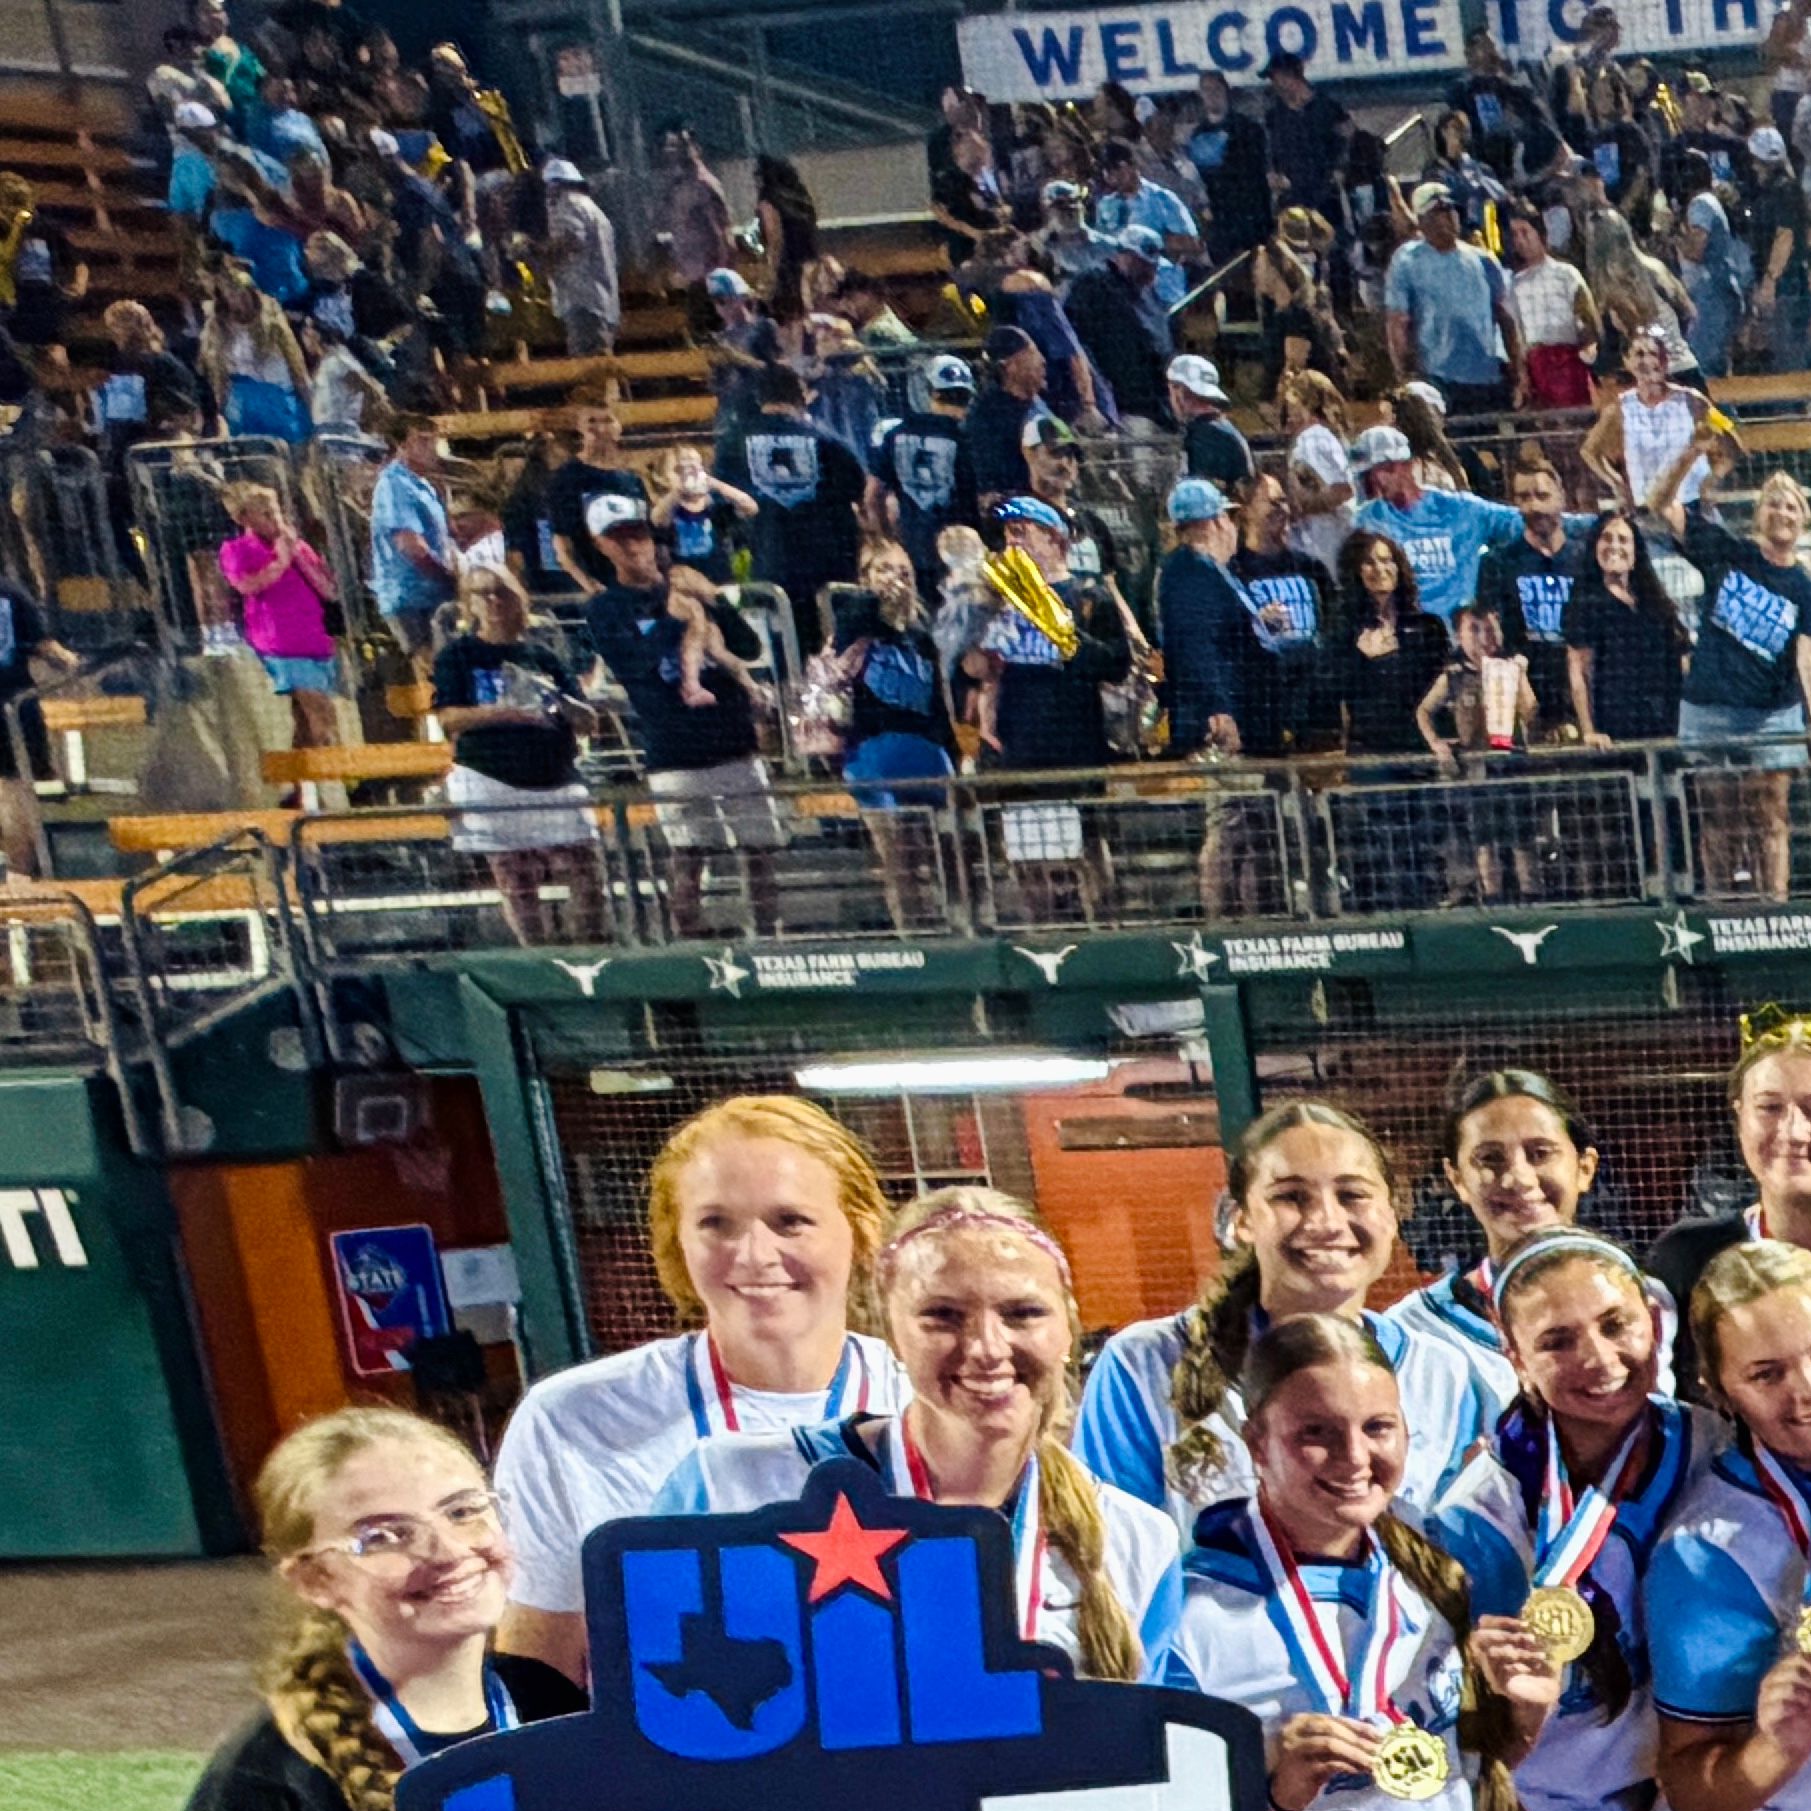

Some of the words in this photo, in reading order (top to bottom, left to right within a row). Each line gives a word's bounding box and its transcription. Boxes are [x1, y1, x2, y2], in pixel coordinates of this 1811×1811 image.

[1012, 0, 1447, 87] WELCOME
[1708, 917, 1766, 935] TEXAS
[1280, 935, 1332, 954] FARM
[1333, 931, 1406, 951] BUREAU
